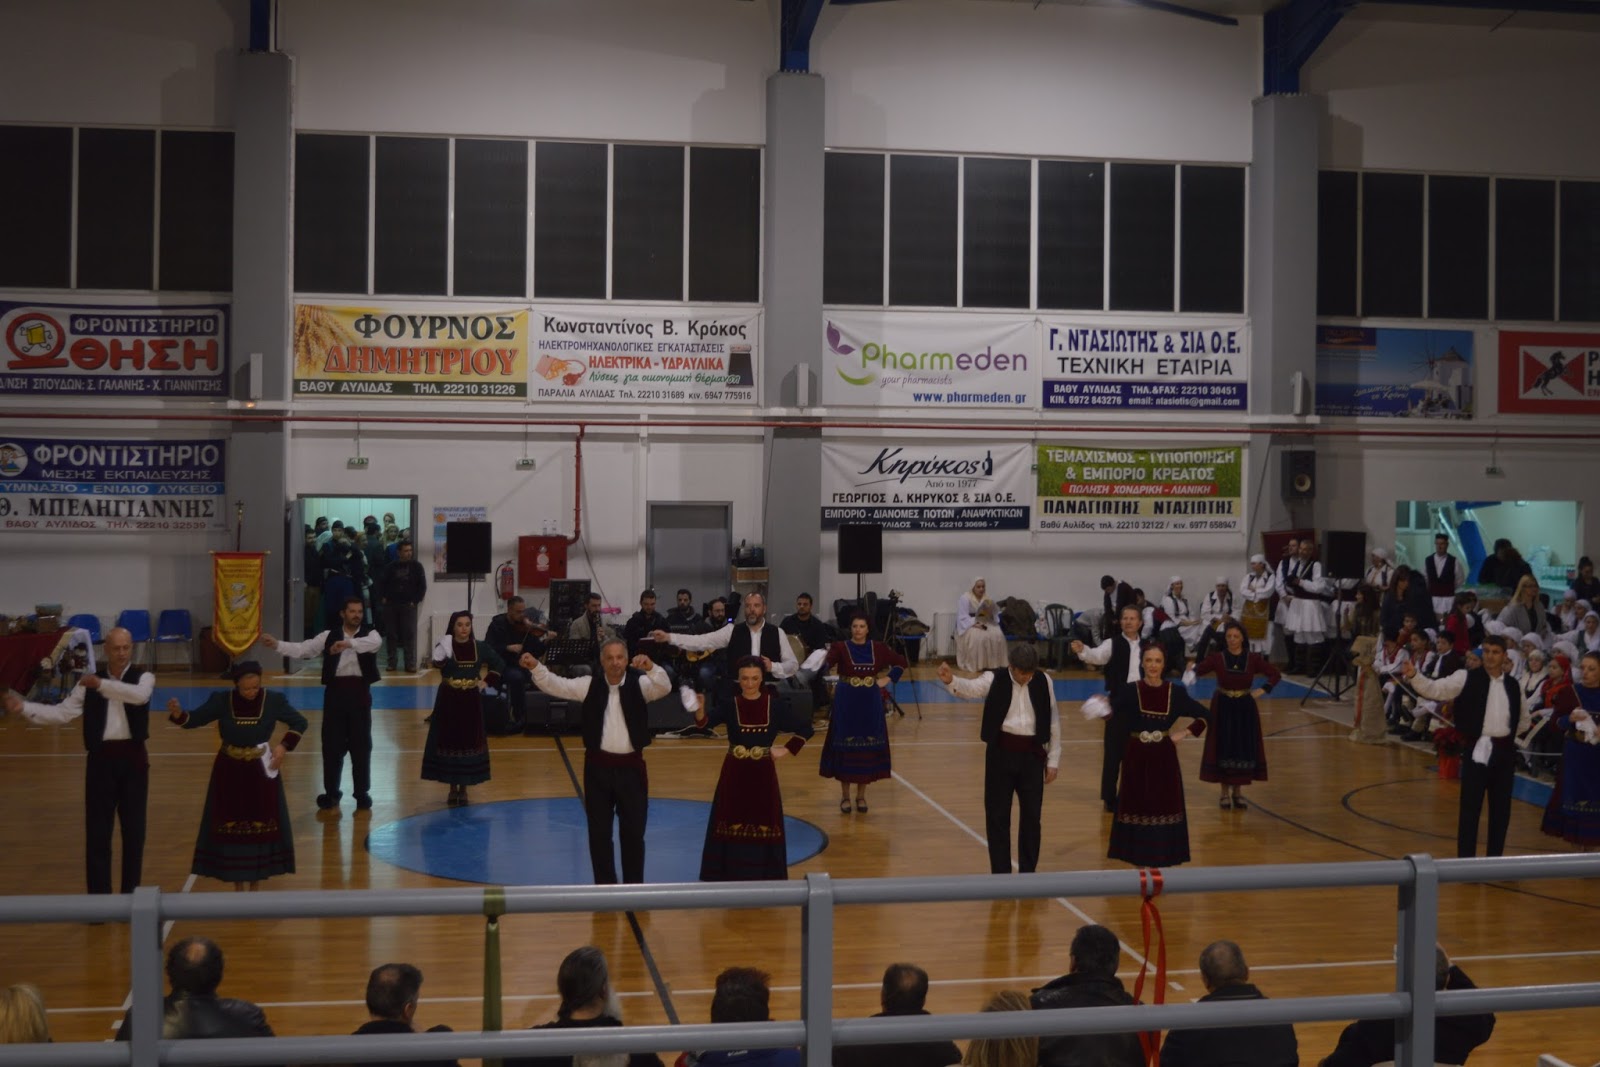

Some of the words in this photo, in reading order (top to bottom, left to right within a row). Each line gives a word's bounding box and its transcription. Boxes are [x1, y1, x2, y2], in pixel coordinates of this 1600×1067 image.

[74, 318, 215, 334] ΦΡΟΝΤΙΣΤΗΡΙΟ
[354, 314, 515, 340] ΦΟΥΡΝΟΣ
[544, 317, 653, 338] Κωνσταντίνος
[663, 320, 678, 336] Β.
[688, 320, 747, 339] Κρόκος
[538, 340, 653, 352] ΗΛΕΚΤΡΟΜΗΧΑΝΟΛΟΓΙΚΕΣ
[657, 343, 725, 353] ΕΓΚΑΤΑΣΤΑΣΕΙΣ
[1050, 328, 1063, 351] Γ.
[1068, 329, 1159, 353] ΝΤΑΣΙΩΤΗΣ
[1163, 335, 1175, 353] &
[1180, 331, 1206, 353] ΣΙΑ
[1210, 331, 1241, 354] Ο.Ε.
[323, 344, 520, 375] ΔΗΜΗΤΡΙΟΥ
[588, 355, 651, 370] ΗΛΕΚΤΡΙΚΑ
[661, 357, 724, 370] ΥΔΡΑΥΛΙΚΑ
[861, 342, 1028, 371] Pharmeden
[1057, 357, 1144, 374] ΤΕΧΝΙΚΗ
[1156, 359, 1233, 375] ΕΤΑΙΡΙΑ
[33, 378, 85, 391] ΣΠΟΥΔΩΝ:
[87, 379, 96, 391] Σ.
[98, 379, 145, 391] ΓΑΛΑΝΗΣ
[152, 380, 162, 391] Χ.
[623, 374, 639, 385] για
[880, 375, 900, 388] your
[902, 373, 953, 388] pharmacists
[300, 381, 334, 392] ΒΑΘΥ
[341, 382, 393, 393] ΑΥΛΙΔΑΣ
[413, 383, 440, 394] ΤΗΛ.
[443, 384, 479, 395] 22210
[481, 384, 516, 395] 31226
[538, 388, 576, 398] ΠΑΡΑΛΙΑ
[579, 389, 615, 398] ΑΥΛΙΔΑΣ
[637, 390, 661, 399] 22210
[704, 391, 723, 400] 6947
[1053, 384, 1079, 394] ΒΑΘΥ
[1082, 385, 1122, 394] ΑΥΛΙΔΑΣ
[1181, 386, 1208, 395] 22210
[1210, 386, 1237, 395] 30451
[912, 391, 1027, 405] www.pharmeden.gr
[1069, 395, 1090, 405] 6972
[1091, 395, 1122, 405] 843276
[1128, 396, 1154, 405] email:
[34, 444, 219, 466] ΦΡΟΝΤΙΣΤΗΡΙΟ
[1046, 449, 1136, 464] ΤΕΜΑΧΙΣΜΟΣ
[857, 447, 978, 484] Κηρύκος
[41, 469, 96, 479] ΜΕΣΗΣ
[104, 470, 212, 480] ΕΚΠΑΙΔΕΥΣΗΣ
[1065, 467, 1077, 480] &
[1083, 467, 1146, 480] ΕΜΠΟΡΙΟ
[1152, 467, 1216, 480] ΚΡΕΑΤΟΣ
[93, 484, 149, 494] ΕΝΙΑΙΟ
[157, 484, 218, 494] ΛΥΚΕΙΟ
[957, 479, 978, 489] 1977
[1068, 484, 1110, 494] ΠΩΛΗΣΗ
[1112, 484, 1163, 495] ΧΟΝΔΡΙΚΗ
[1170, 485, 1211, 495] ΛΙΑΝΙΚΗ
[832, 493, 887, 504] ΓΕΩΡΓΙΟΣ
[892, 493, 903, 504] Δ.
[906, 493, 959, 504] ΚΗΡΥΚΟΣ
[962, 493, 971, 504] &
[974, 493, 991, 503] ΣΙΑ
[994, 493, 1016, 503] Ο.Ε.
[28, 498, 215, 518] ΜΠΕΛΗΓΙΑΝΝΗΣ
[824, 509, 866, 519] ΕΜΠΟΡΙΟ
[873, 509, 920, 519] ΔΙΑΝΟΜΕΣ
[961, 508, 1023, 518] ΑΝΑΨΥΚΤΙΚΩΝ
[1044, 500, 1140, 514] ΠΑΝΑΓΙΩΤΗΣ
[1153, 500, 1234, 514] ΝΤΑΣΙΩΤΗΣ
[6, 520, 39, 529] ΒΑΘΥ
[45, 520, 97, 529] ΑΥΛΙΔΟΣ
[107, 520, 133, 529] ΤΗΛ.
[136, 521, 170, 530] 22210
[172, 521, 207, 530] 32539
[1040, 520, 1063, 529] Βαθύ
[1063, 520, 1095, 530] Αυλίδος
[1099, 521, 1114, 530] τηλ.
[1116, 521, 1140, 529] 22210
[1141, 521, 1165, 529] 32122
